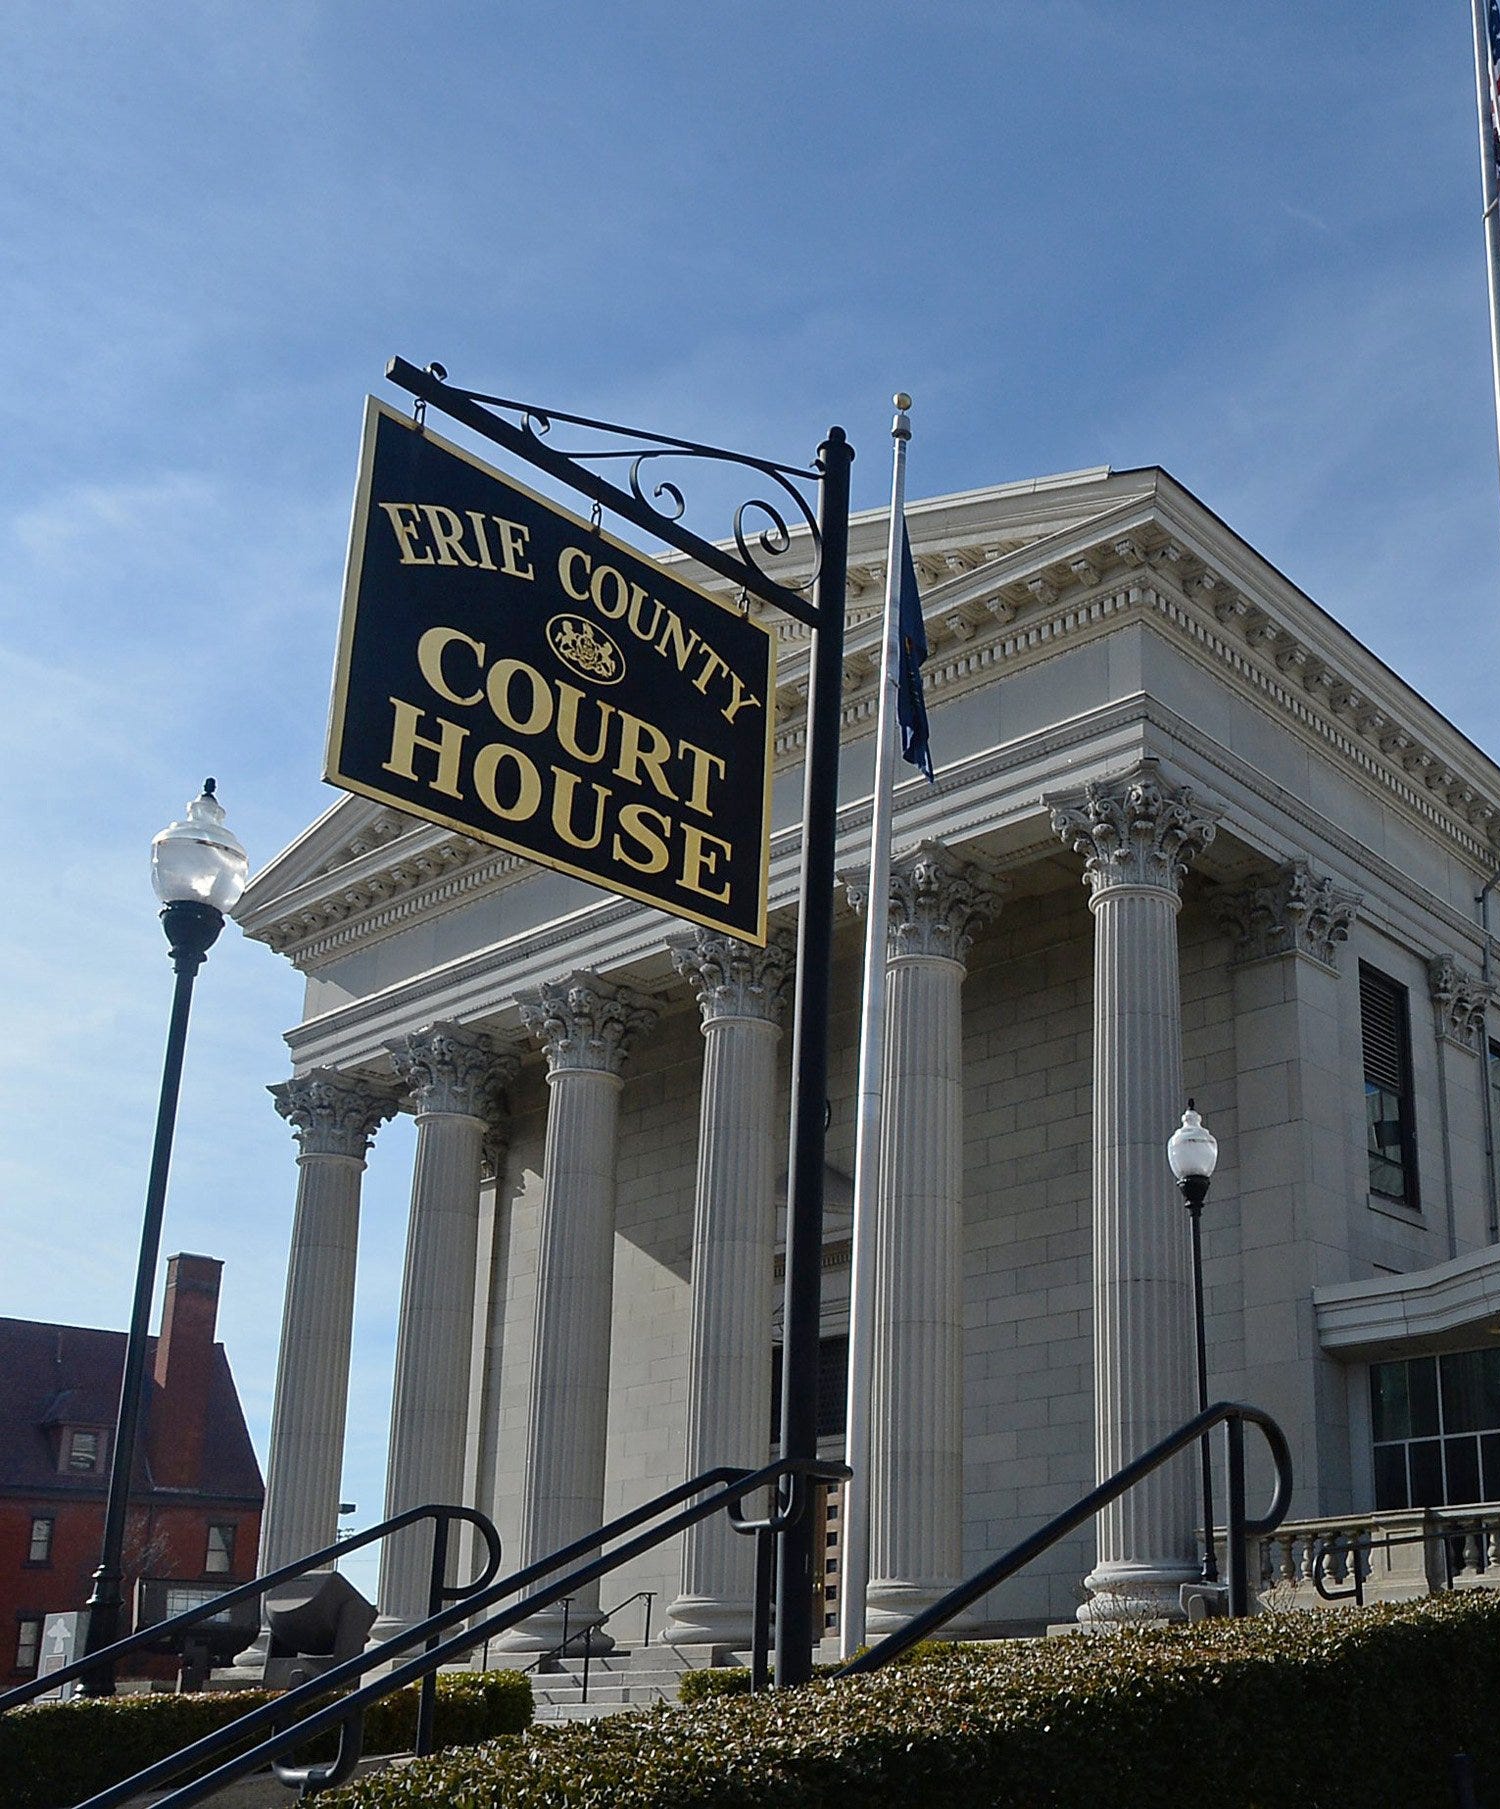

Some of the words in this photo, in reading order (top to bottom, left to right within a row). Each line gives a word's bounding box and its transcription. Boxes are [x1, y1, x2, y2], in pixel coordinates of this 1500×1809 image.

[379, 502, 534, 581] ERIE
[558, 546, 760, 725] COUNTY
[381, 697, 732, 905] HOUSE
[416, 626, 726, 818] COURT
